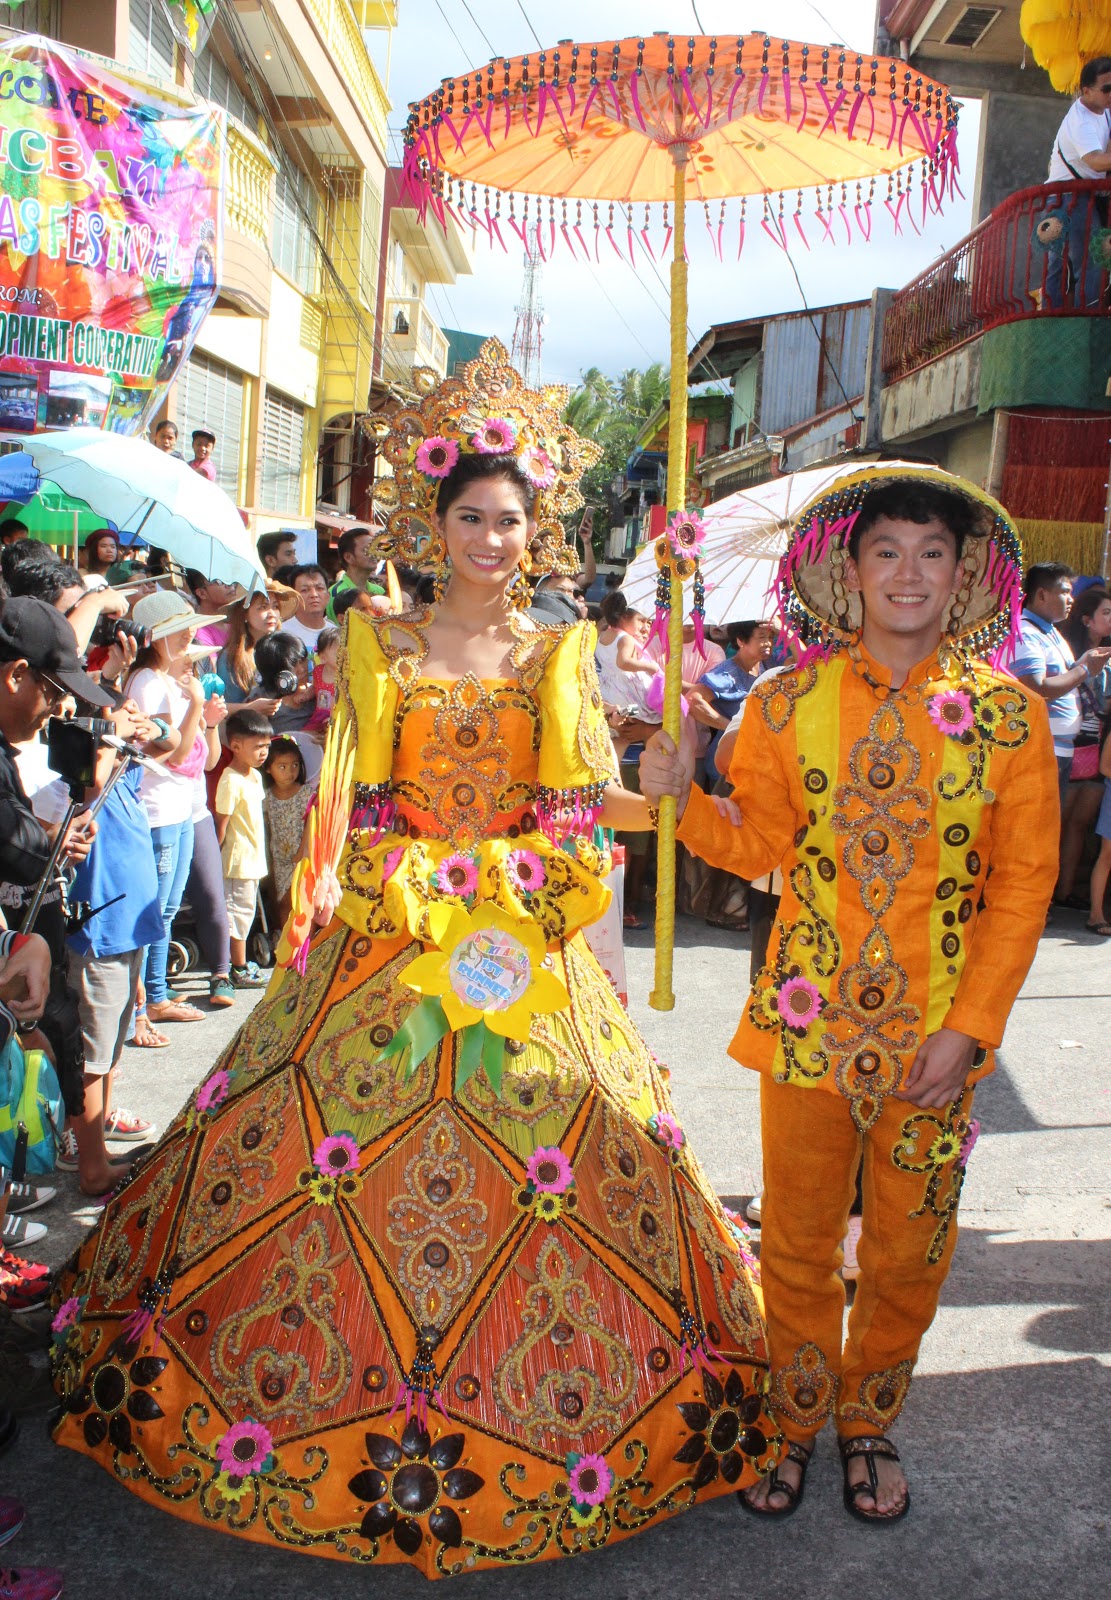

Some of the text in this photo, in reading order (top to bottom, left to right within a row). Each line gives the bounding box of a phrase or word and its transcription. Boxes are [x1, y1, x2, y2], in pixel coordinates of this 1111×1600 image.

[0, 125, 157, 209] CBAN
[48, 201, 183, 284] FESTIVAL
[73, 322, 161, 378] COOPERATIVE
[456, 960, 512, 1001] RUNNER
[480, 958, 506, 978] 1ST
[464, 983, 487, 1002] UP
